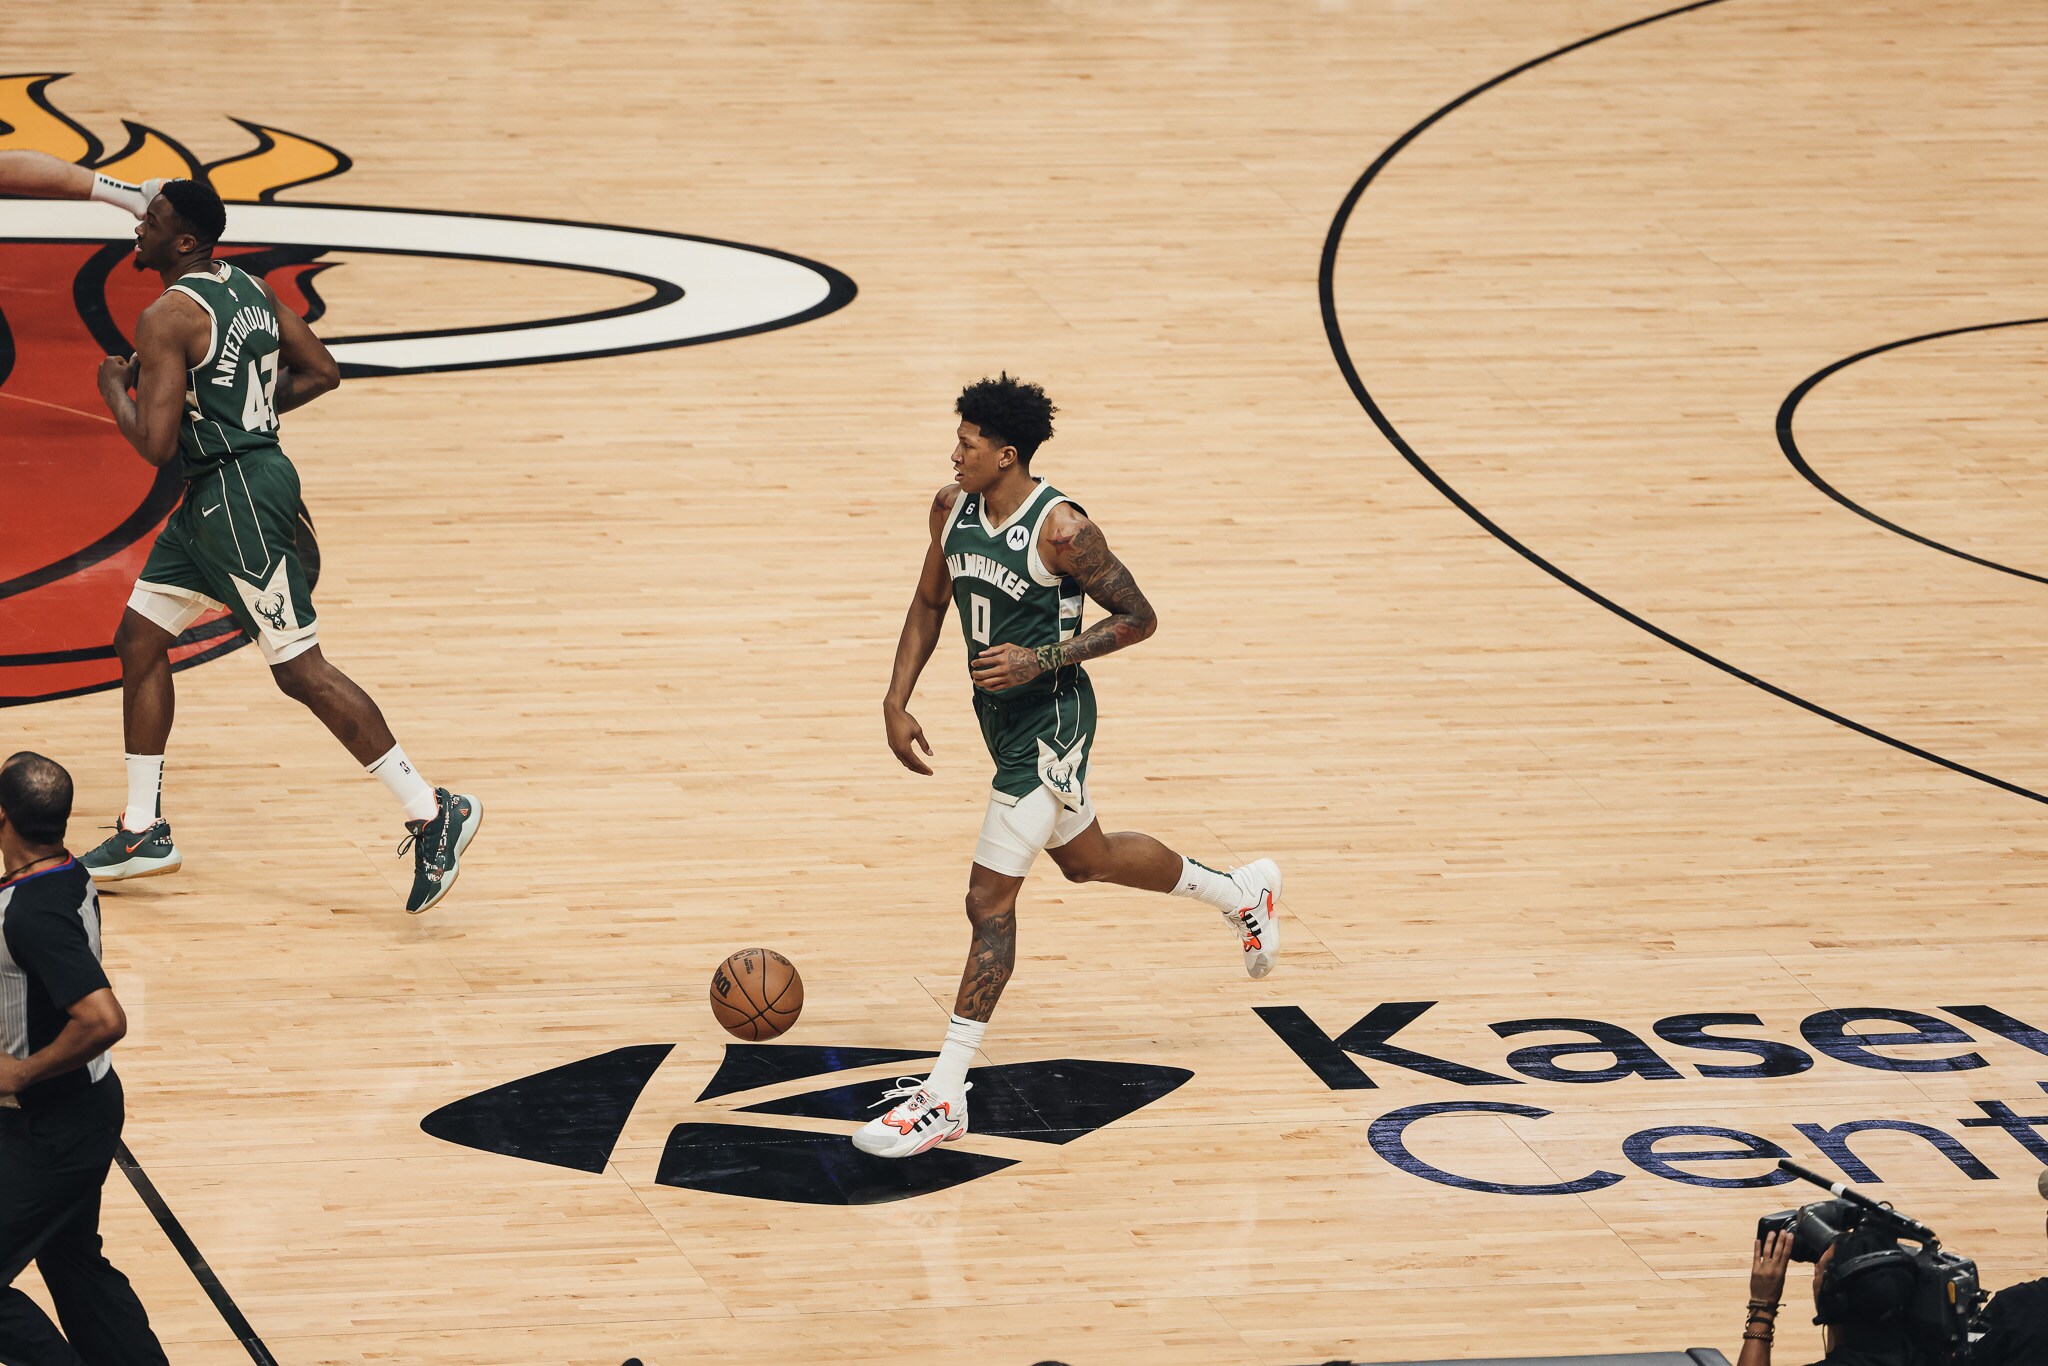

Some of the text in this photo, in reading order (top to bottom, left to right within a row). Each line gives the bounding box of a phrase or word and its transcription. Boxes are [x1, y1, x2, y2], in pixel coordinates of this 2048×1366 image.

[965, 502, 976, 515] 6
[946, 552, 1031, 602] MILWAUKEE
[970, 592, 991, 647] 0
